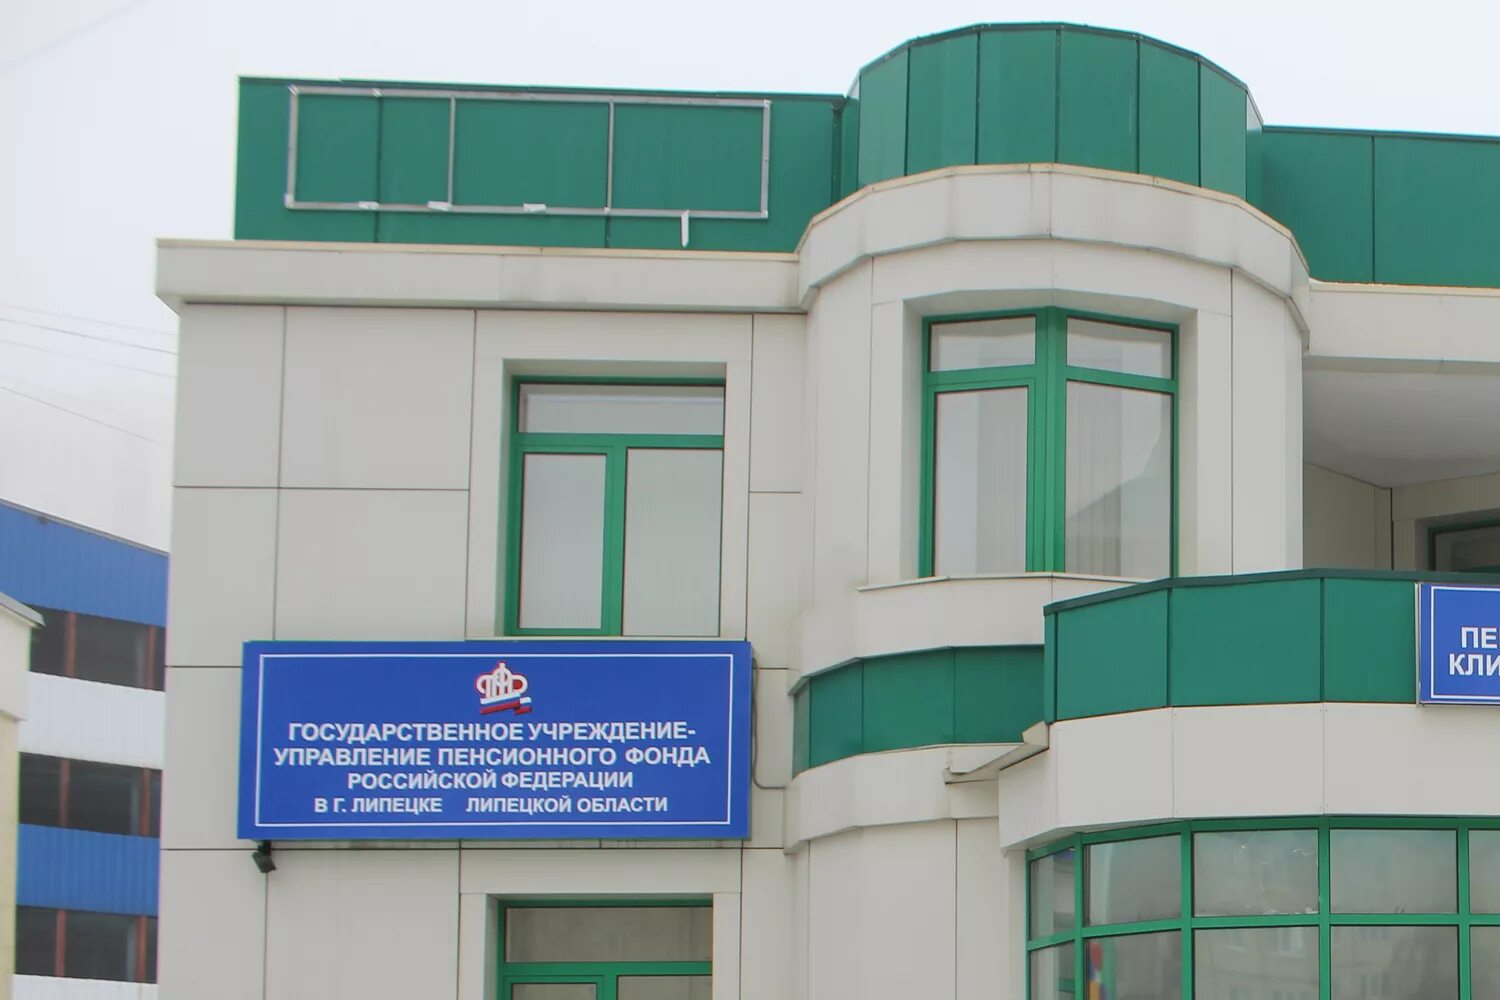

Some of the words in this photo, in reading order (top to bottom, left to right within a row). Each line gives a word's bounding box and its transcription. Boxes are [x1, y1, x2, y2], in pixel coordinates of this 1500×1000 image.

[288, 722, 523, 745] ГОСУДАРСТВЕННОЕ
[529, 721, 696, 742] УЧРЕЖДЕНИЕ-
[274, 747, 431, 767] УПРАВЛЕНИЕ
[437, 747, 617, 767] ПЕНСИОННОГО
[625, 746, 711, 768] ФОНДА
[347, 770, 497, 790] РОССИЙСКОЙ
[501, 771, 634, 791] ФЕДЕРАЦИИ
[314, 798, 327, 813] В
[333, 798, 346, 813] Г.
[351, 797, 443, 816] ЛИПЕЦКЕ
[466, 794, 572, 815] ЛИПЕЦКОЙ
[576, 797, 668, 813] ОБЛАСТИ
